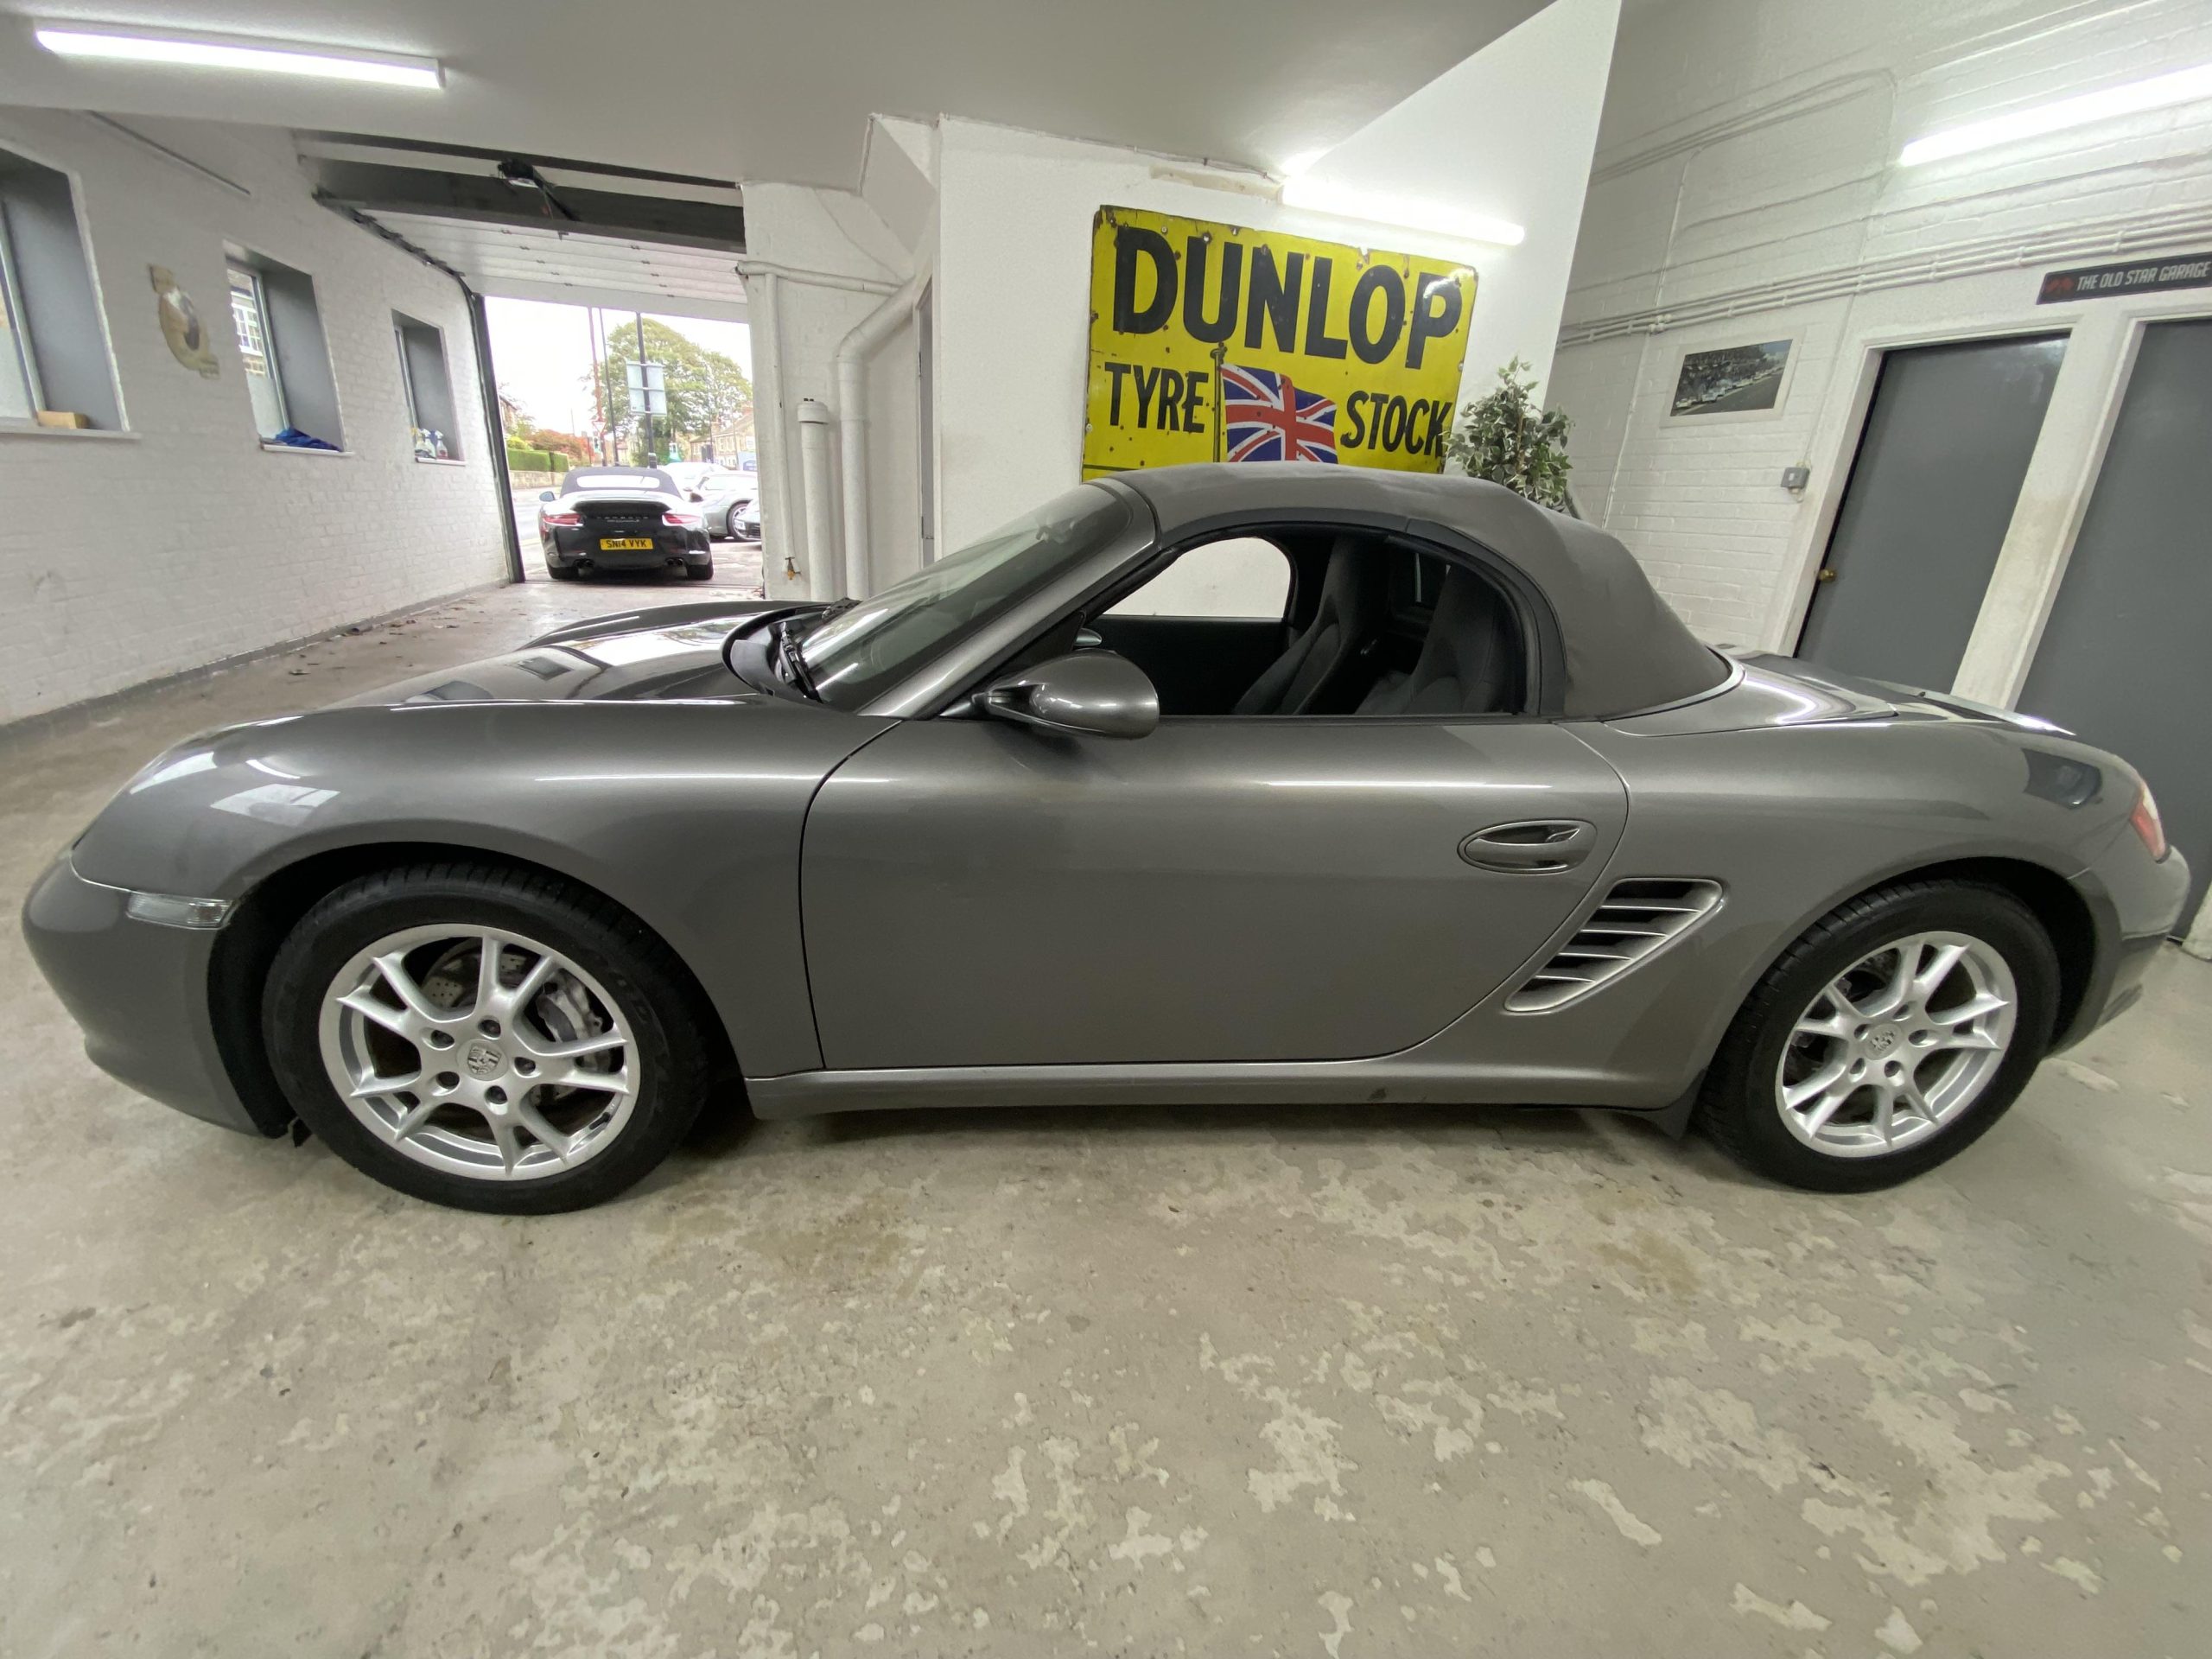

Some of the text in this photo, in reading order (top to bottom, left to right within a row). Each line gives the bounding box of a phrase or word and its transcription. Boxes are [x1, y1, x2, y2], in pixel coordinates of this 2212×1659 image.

[1113, 226, 1462, 370] DUNLOP
[2077, 261, 2211, 291] THE OLD STAR GARAGE
[1104, 362, 1453, 457] TYRE STOCK
[607, 539, 647, 549] SN14 VYK
